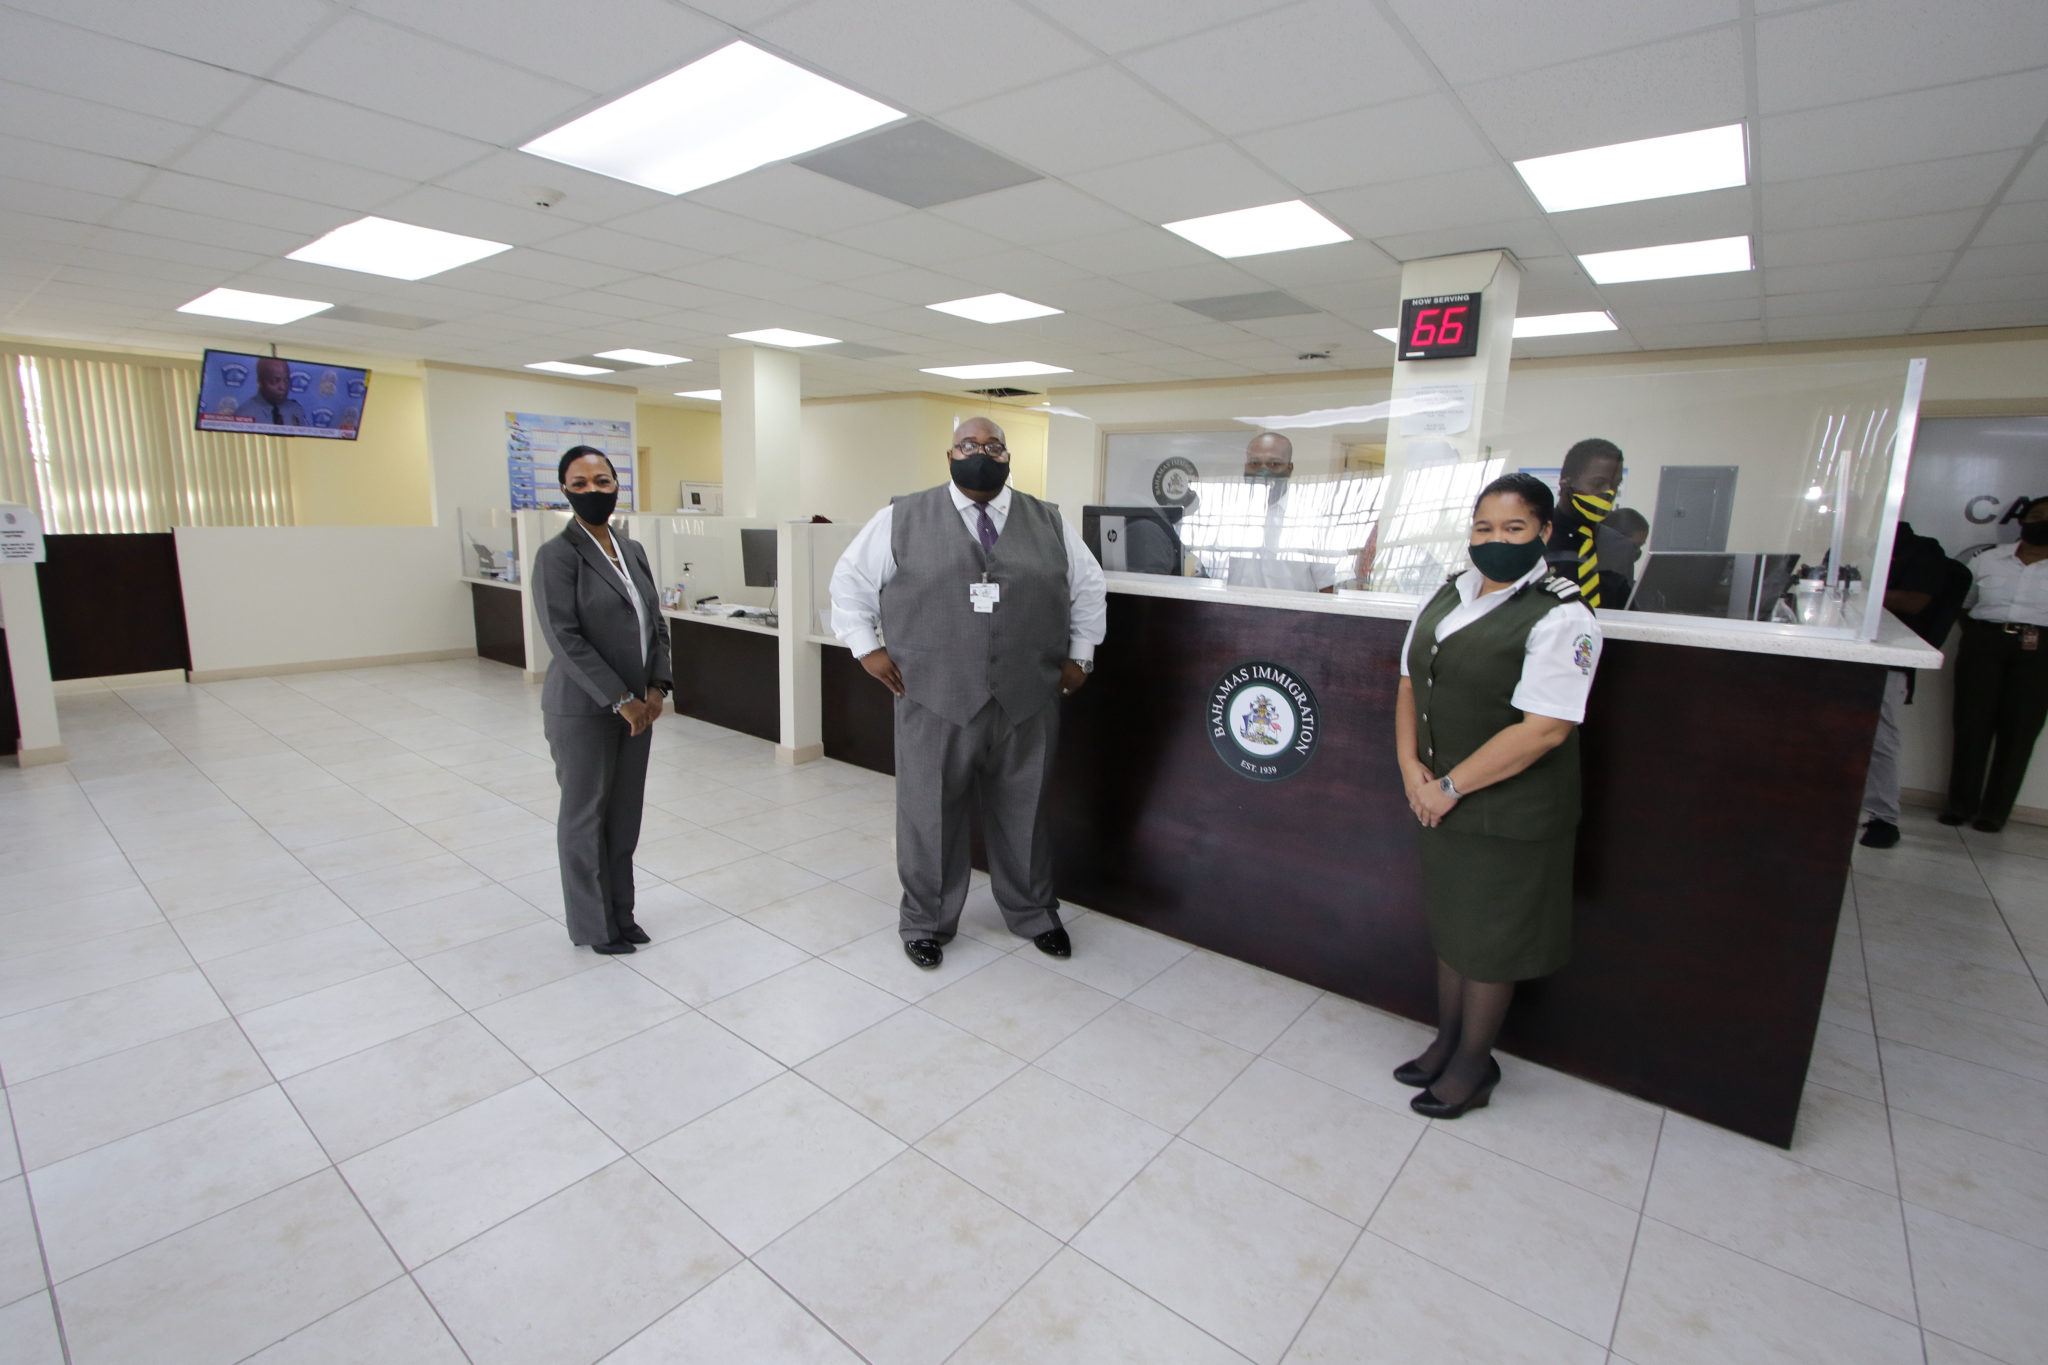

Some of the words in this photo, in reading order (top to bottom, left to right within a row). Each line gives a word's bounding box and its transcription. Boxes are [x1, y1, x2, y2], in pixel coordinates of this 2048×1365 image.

[1412, 298, 1431, 306] NOW
[1433, 294, 1470, 304] SERVING
[1410, 306, 1468, 347] 66
[1211, 668, 1250, 738] BAHAMAS
[1252, 665, 1315, 755] IMMIGRATION
[1240, 760, 1258, 773] EST.
[1260, 766, 1277, 775] 1939
